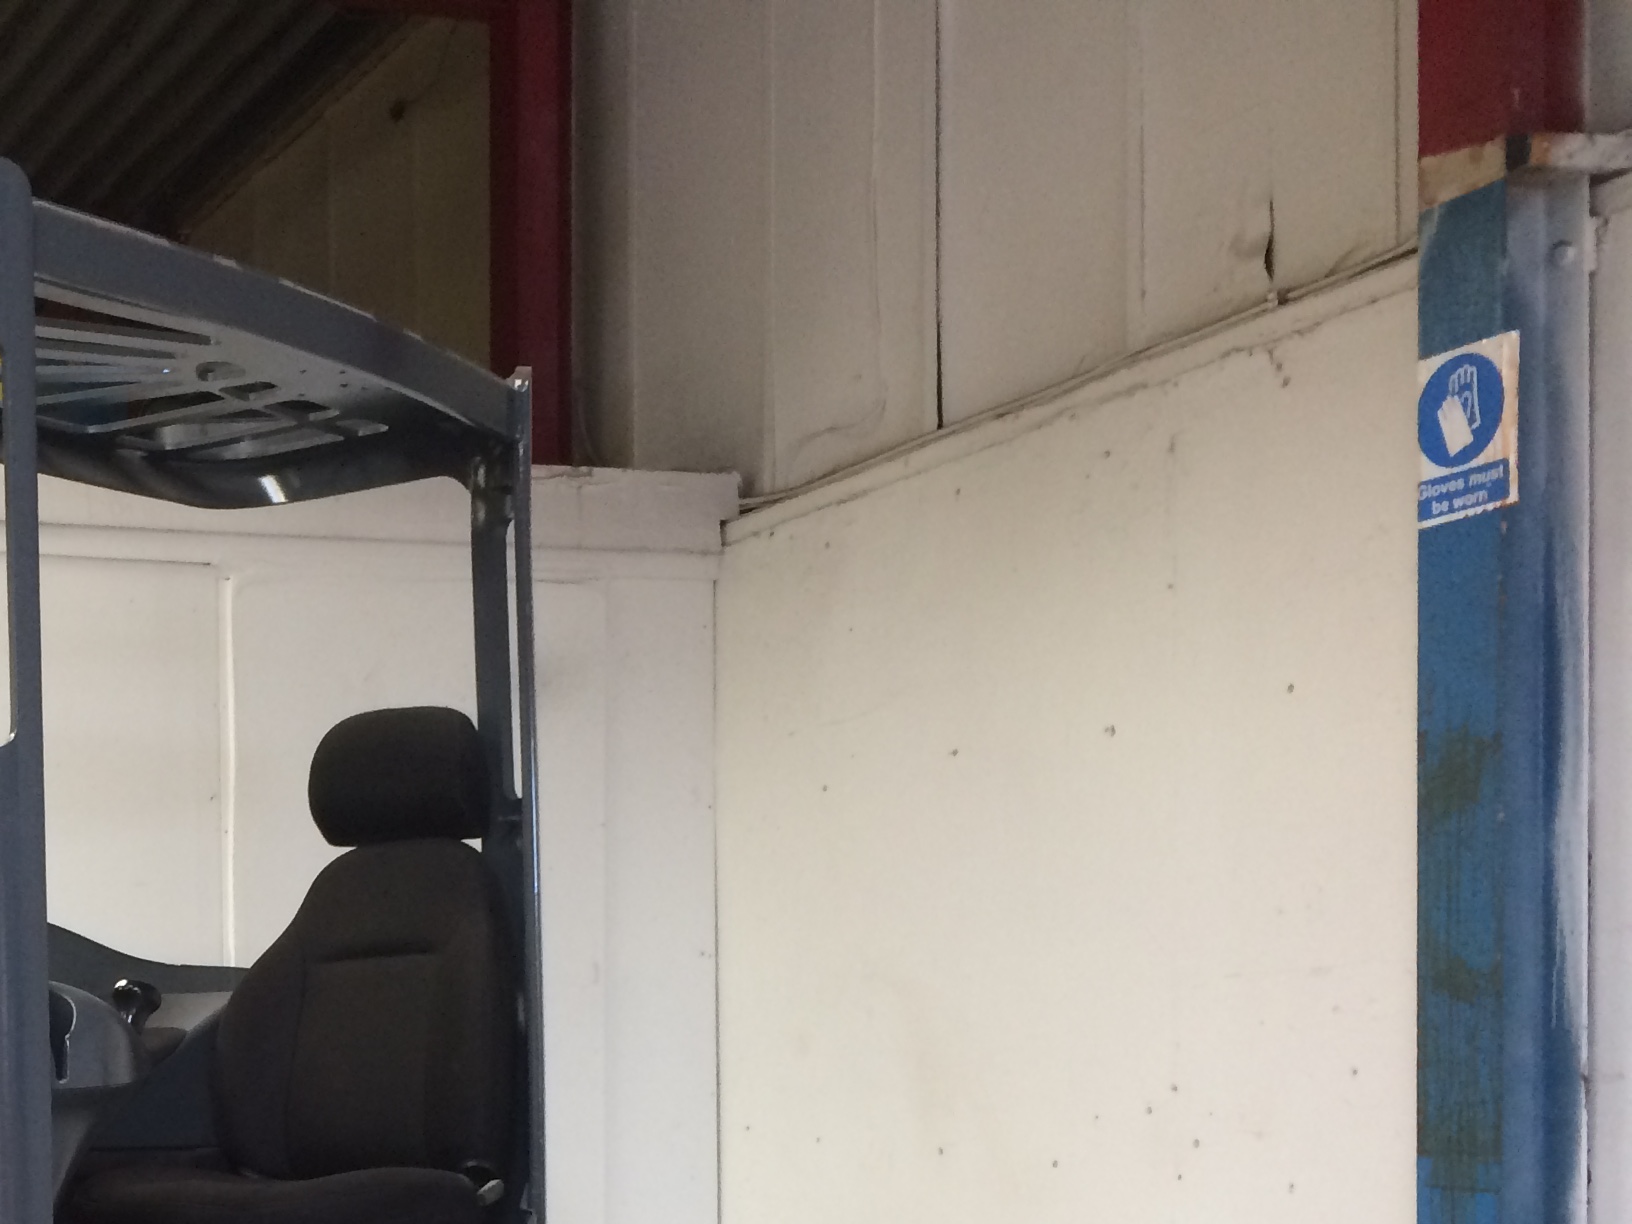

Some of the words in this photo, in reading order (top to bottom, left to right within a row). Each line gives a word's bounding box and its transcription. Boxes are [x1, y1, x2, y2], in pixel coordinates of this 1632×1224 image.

[1419, 479, 1465, 501] Gloves
[1469, 464, 1504, 488] must
[1432, 501, 1450, 515] be
[1452, 490, 1488, 509] worn
